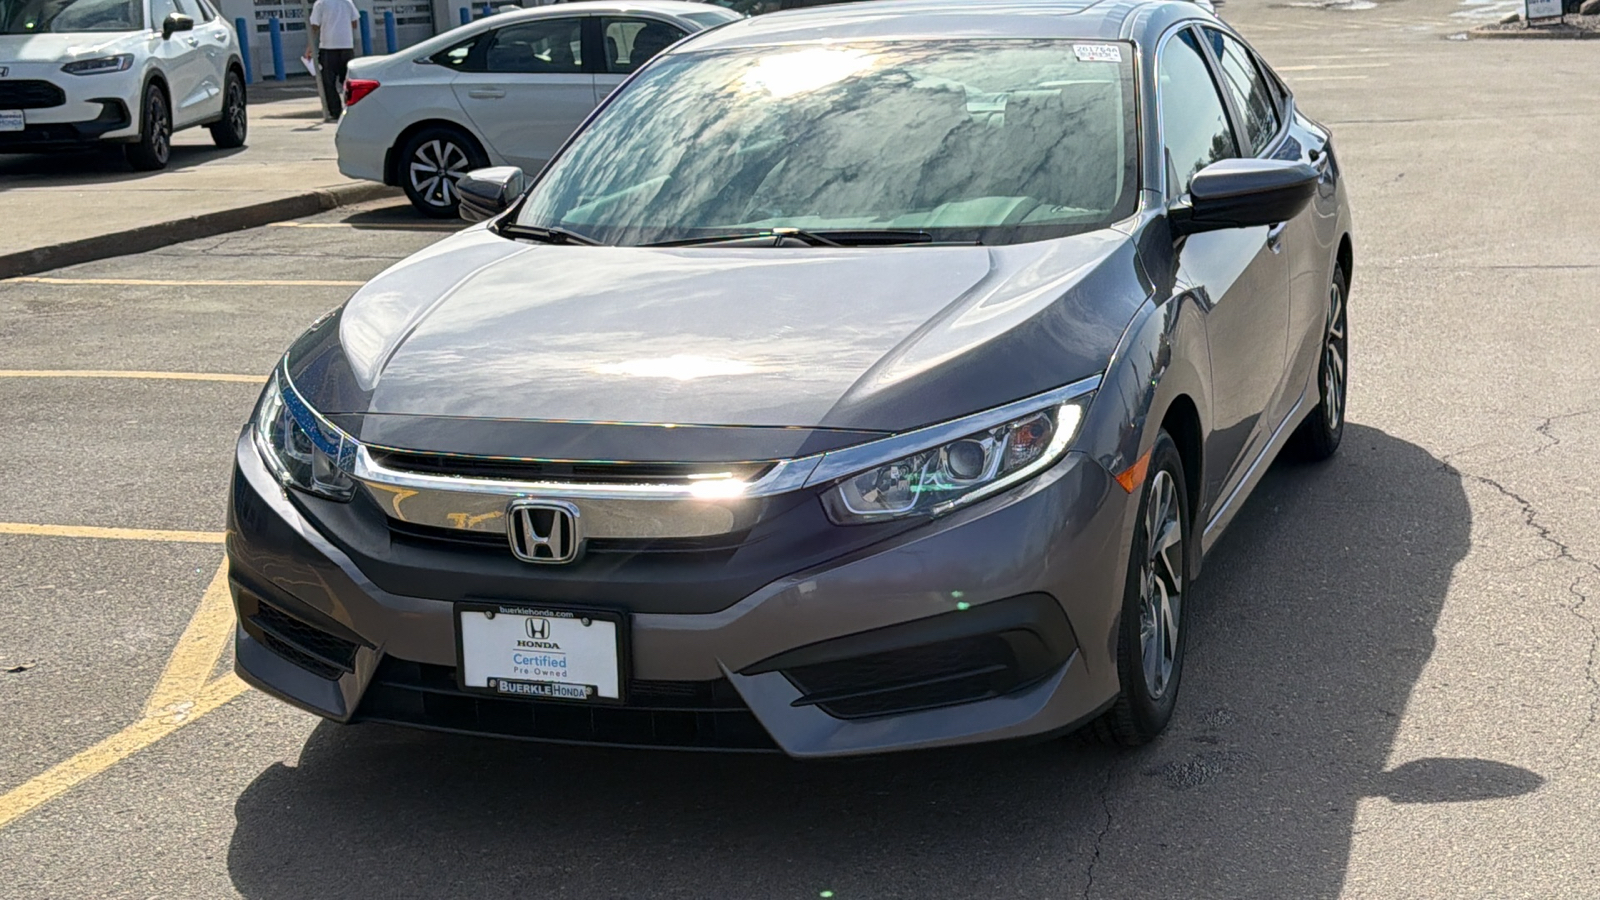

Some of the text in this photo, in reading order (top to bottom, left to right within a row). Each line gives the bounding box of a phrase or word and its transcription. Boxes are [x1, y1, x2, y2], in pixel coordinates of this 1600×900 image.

[499, 606, 574, 618] buerklehonda.com
[517, 640, 561, 650] HONDA
[513, 653, 567, 668] Certified
[499, 681, 551, 694] BUERKLE
[552, 684, 585, 698] HONDA
